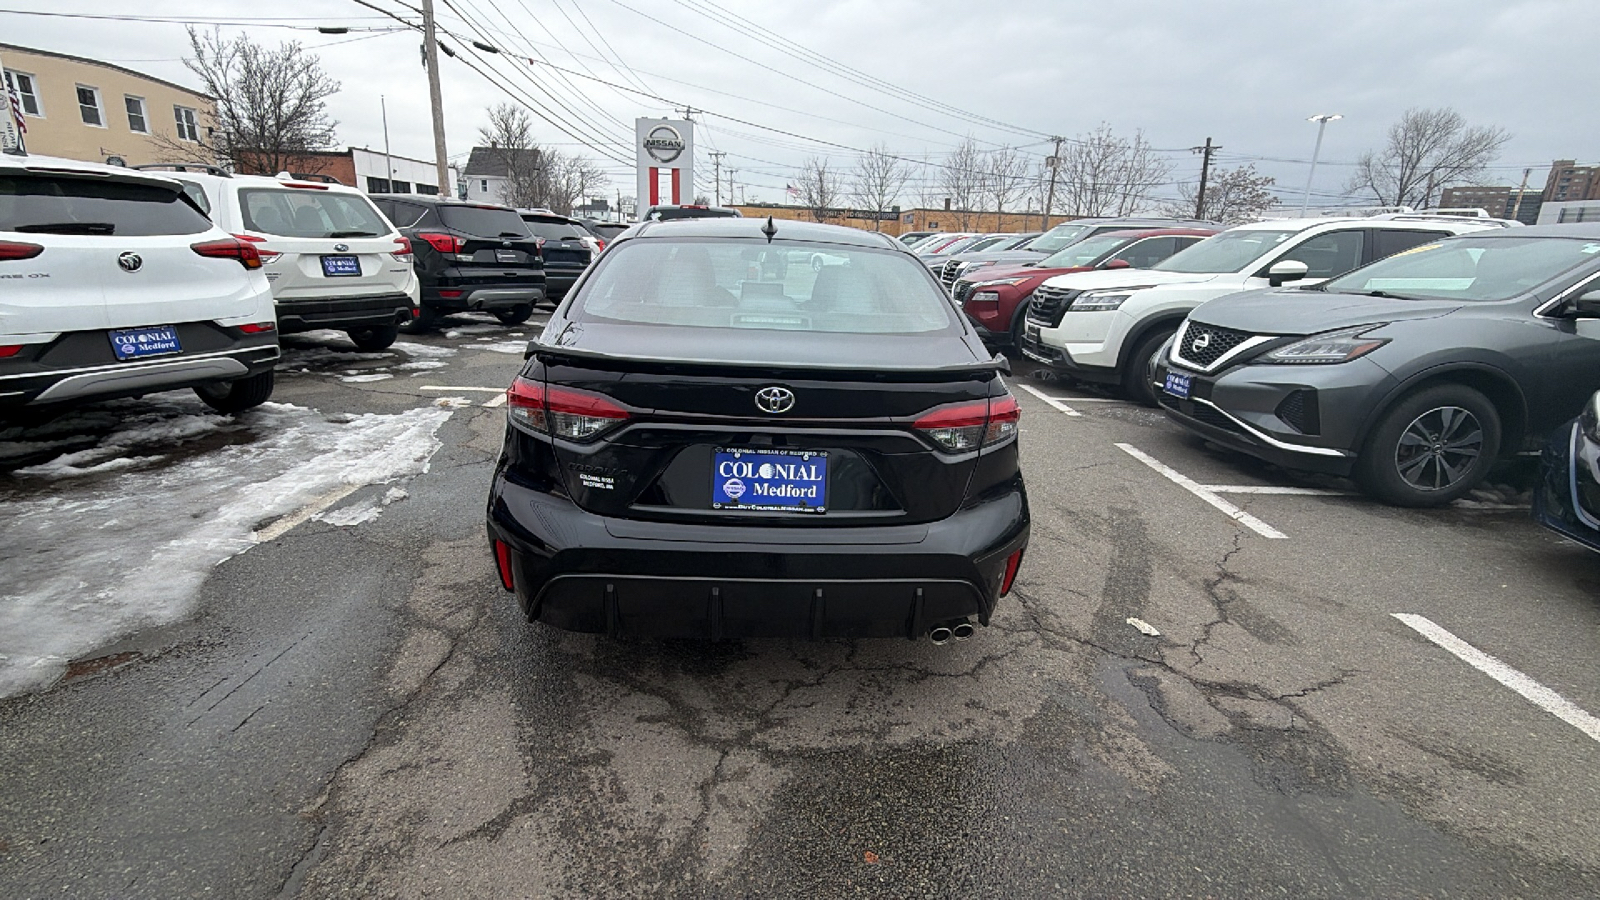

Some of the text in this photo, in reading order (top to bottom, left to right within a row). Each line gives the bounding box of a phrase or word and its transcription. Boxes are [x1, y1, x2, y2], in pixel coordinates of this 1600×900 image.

[646, 139, 681, 148] NISSAN
[115, 331, 176, 345] COLONIAL
[138, 341, 176, 351] Medford
[719, 461, 822, 481] COLONIAL
[752, 482, 817, 498] Medford
